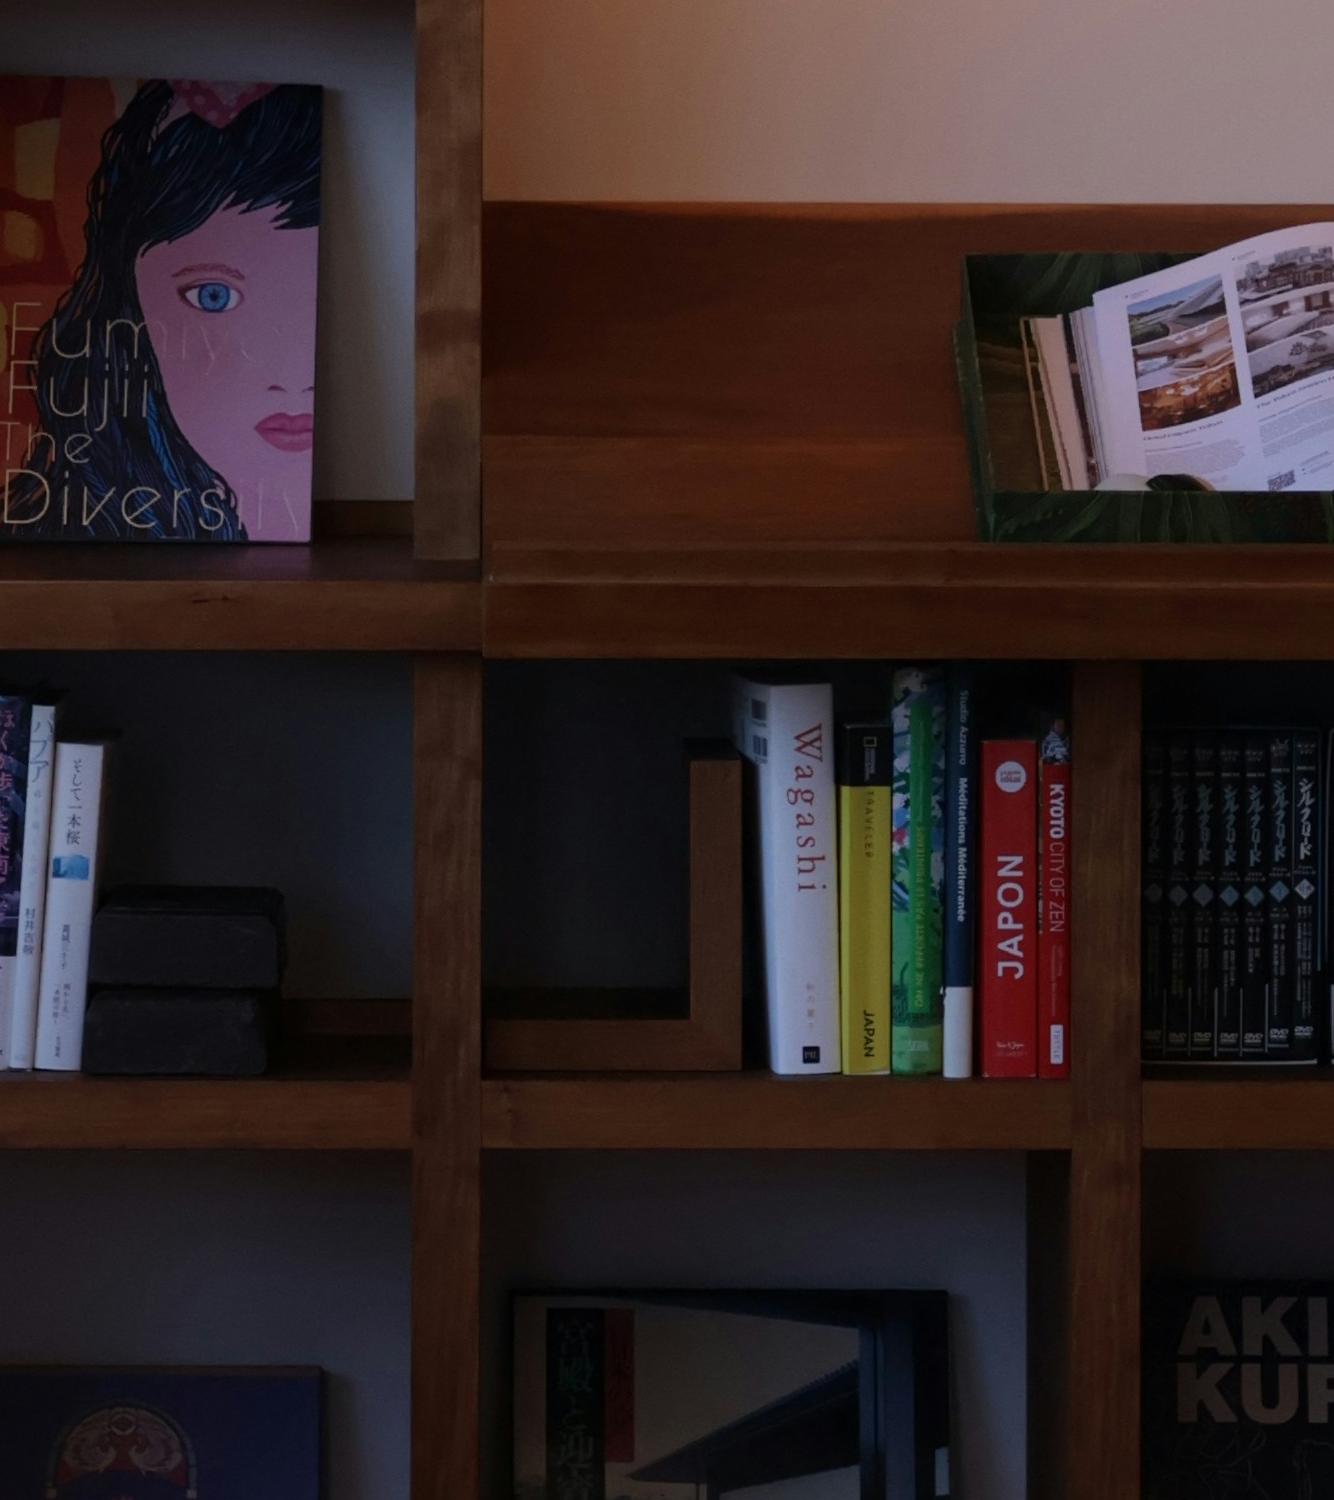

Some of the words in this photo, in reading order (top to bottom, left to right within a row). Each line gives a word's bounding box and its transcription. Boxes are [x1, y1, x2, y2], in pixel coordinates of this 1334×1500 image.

[7, 360, 149, 433] Fujii
[960, 689, 970, 723] Studio
[959, 726, 969, 766] Azzurro
[66, 759, 81, 846] そして一本桜
[786, 722, 827, 893] Wagashi
[958, 777, 969, 844] Méditations
[1049, 783, 1065, 839] KYOTO
[1221, 783, 1240, 867] シルクロード
[1246, 783, 1265, 868] シルクロード
[1271, 779, 1290, 863] シルクロード
[1297, 777, 1316, 861] シルクロード
[957, 846, 968, 923] Méditerranée
[1049, 841, 1065, 873] CITY
[1049, 877, 1065, 898] OF
[996, 854, 1026, 980] JAPON
[1049, 902, 1065, 933] ZEN
[863, 1009, 876, 1058] JAPAN
[1175, 1294, 1329, 1358] AKI
